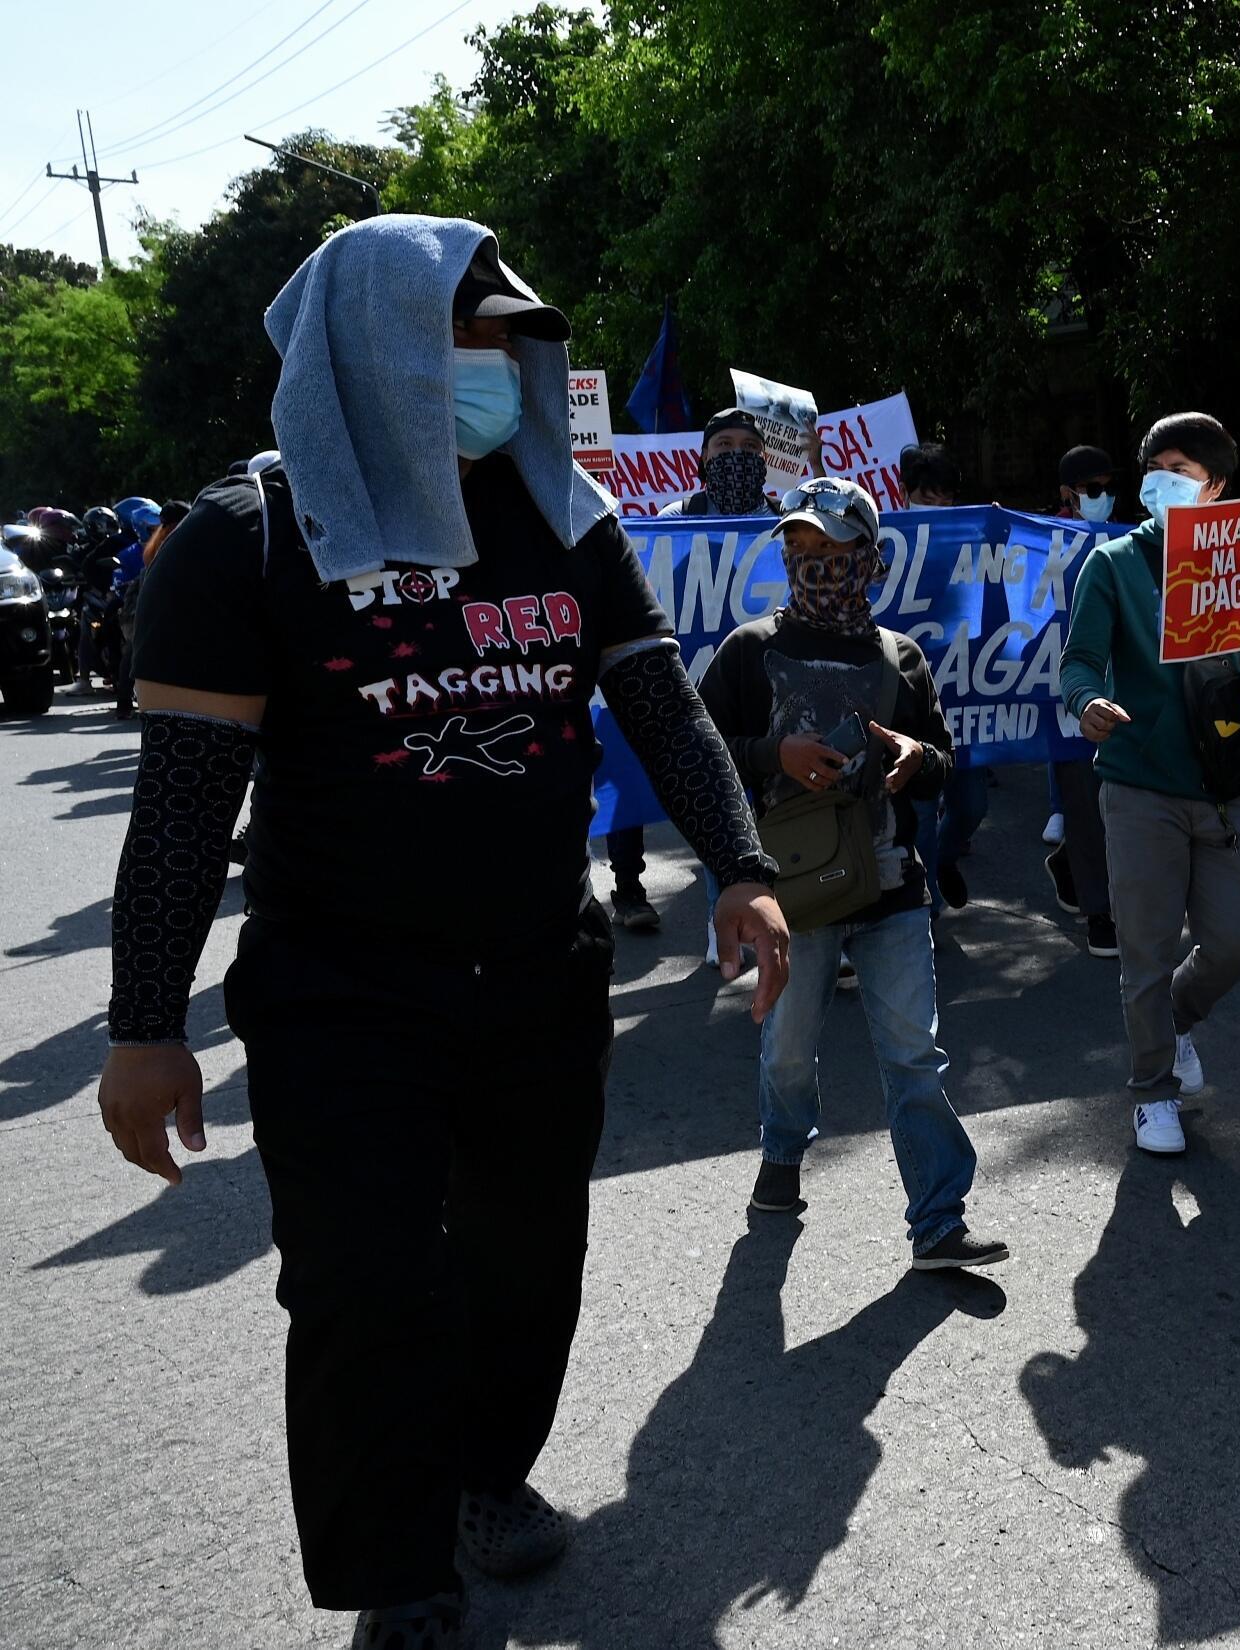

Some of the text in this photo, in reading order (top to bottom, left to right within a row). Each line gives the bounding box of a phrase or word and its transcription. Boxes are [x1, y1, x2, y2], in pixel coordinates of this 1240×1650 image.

[783, 425, 799, 442] FOR
[949, 543, 1028, 585] ANG
[1211, 549, 1236, 577] NA
[462, 591, 582, 656] RED
[358, 664, 573, 714] TAGGING
